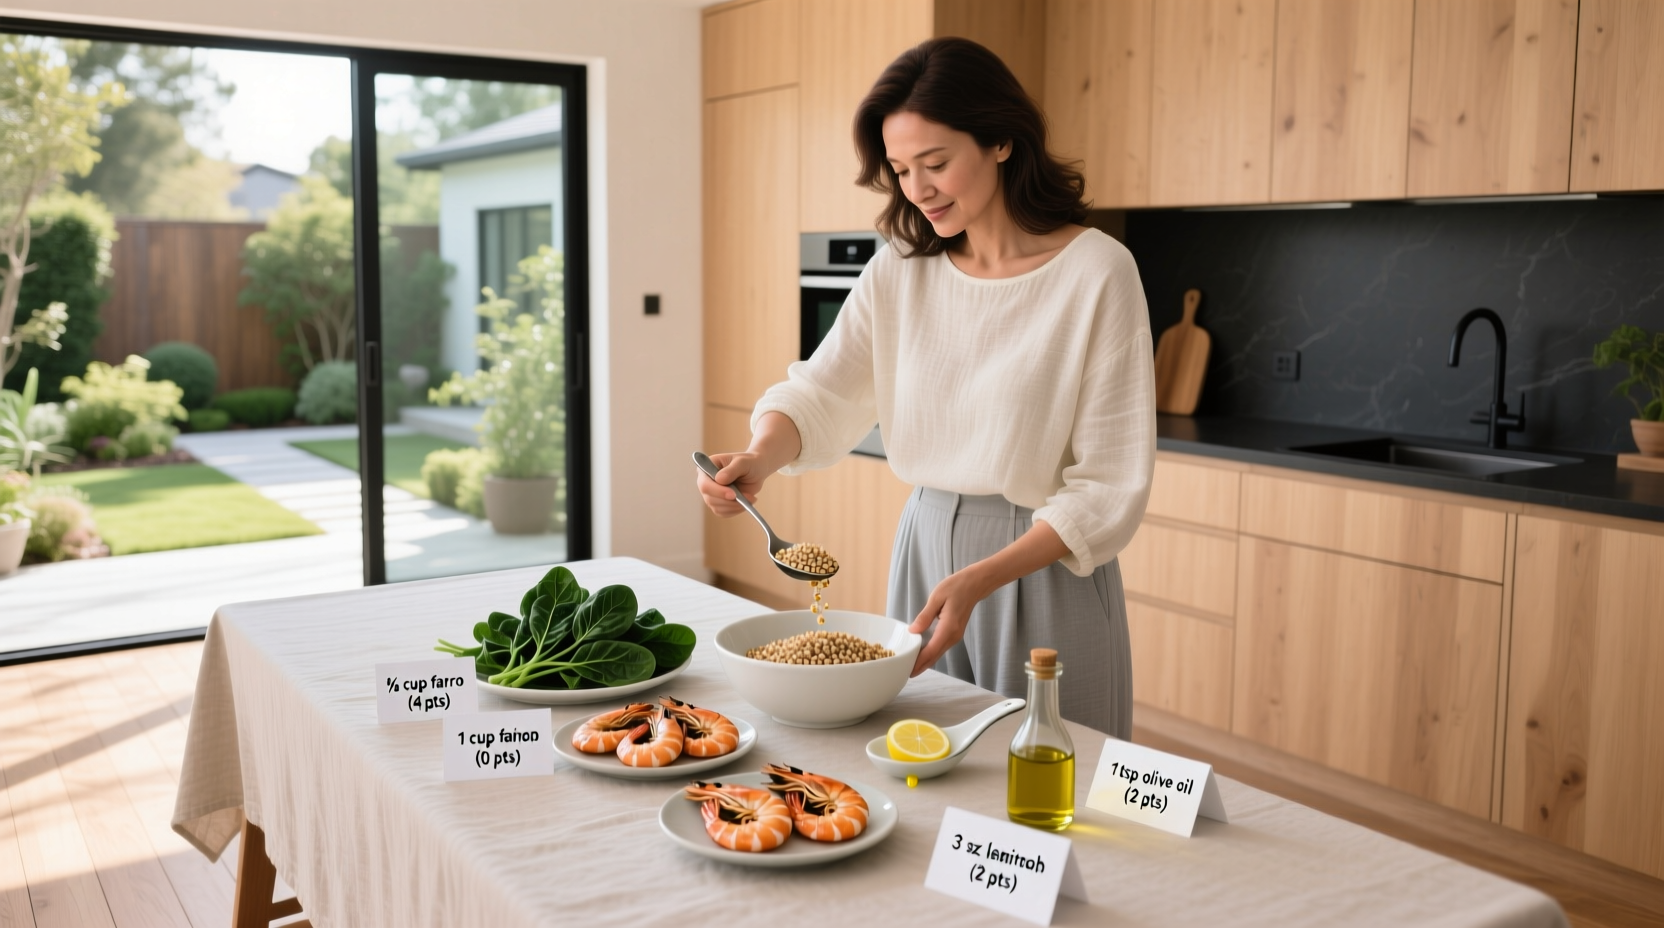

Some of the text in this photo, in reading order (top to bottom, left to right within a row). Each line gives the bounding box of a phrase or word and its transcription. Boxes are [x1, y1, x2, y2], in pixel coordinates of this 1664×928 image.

[403, 679, 427, 692] cup
[431, 675, 464, 689] farro
[408, 693, 450, 712] (4 pts)
[458, 732, 464, 745] 1
[469, 732, 495, 748] cup
[476, 750, 521, 770] (0 pts)
[1112, 762, 1194, 795] 1 tsp olive oil
[1124, 786, 1168, 814] (2 pts)
[952, 834, 962, 850] 3
[970, 864, 1018, 894] (2 pts)
